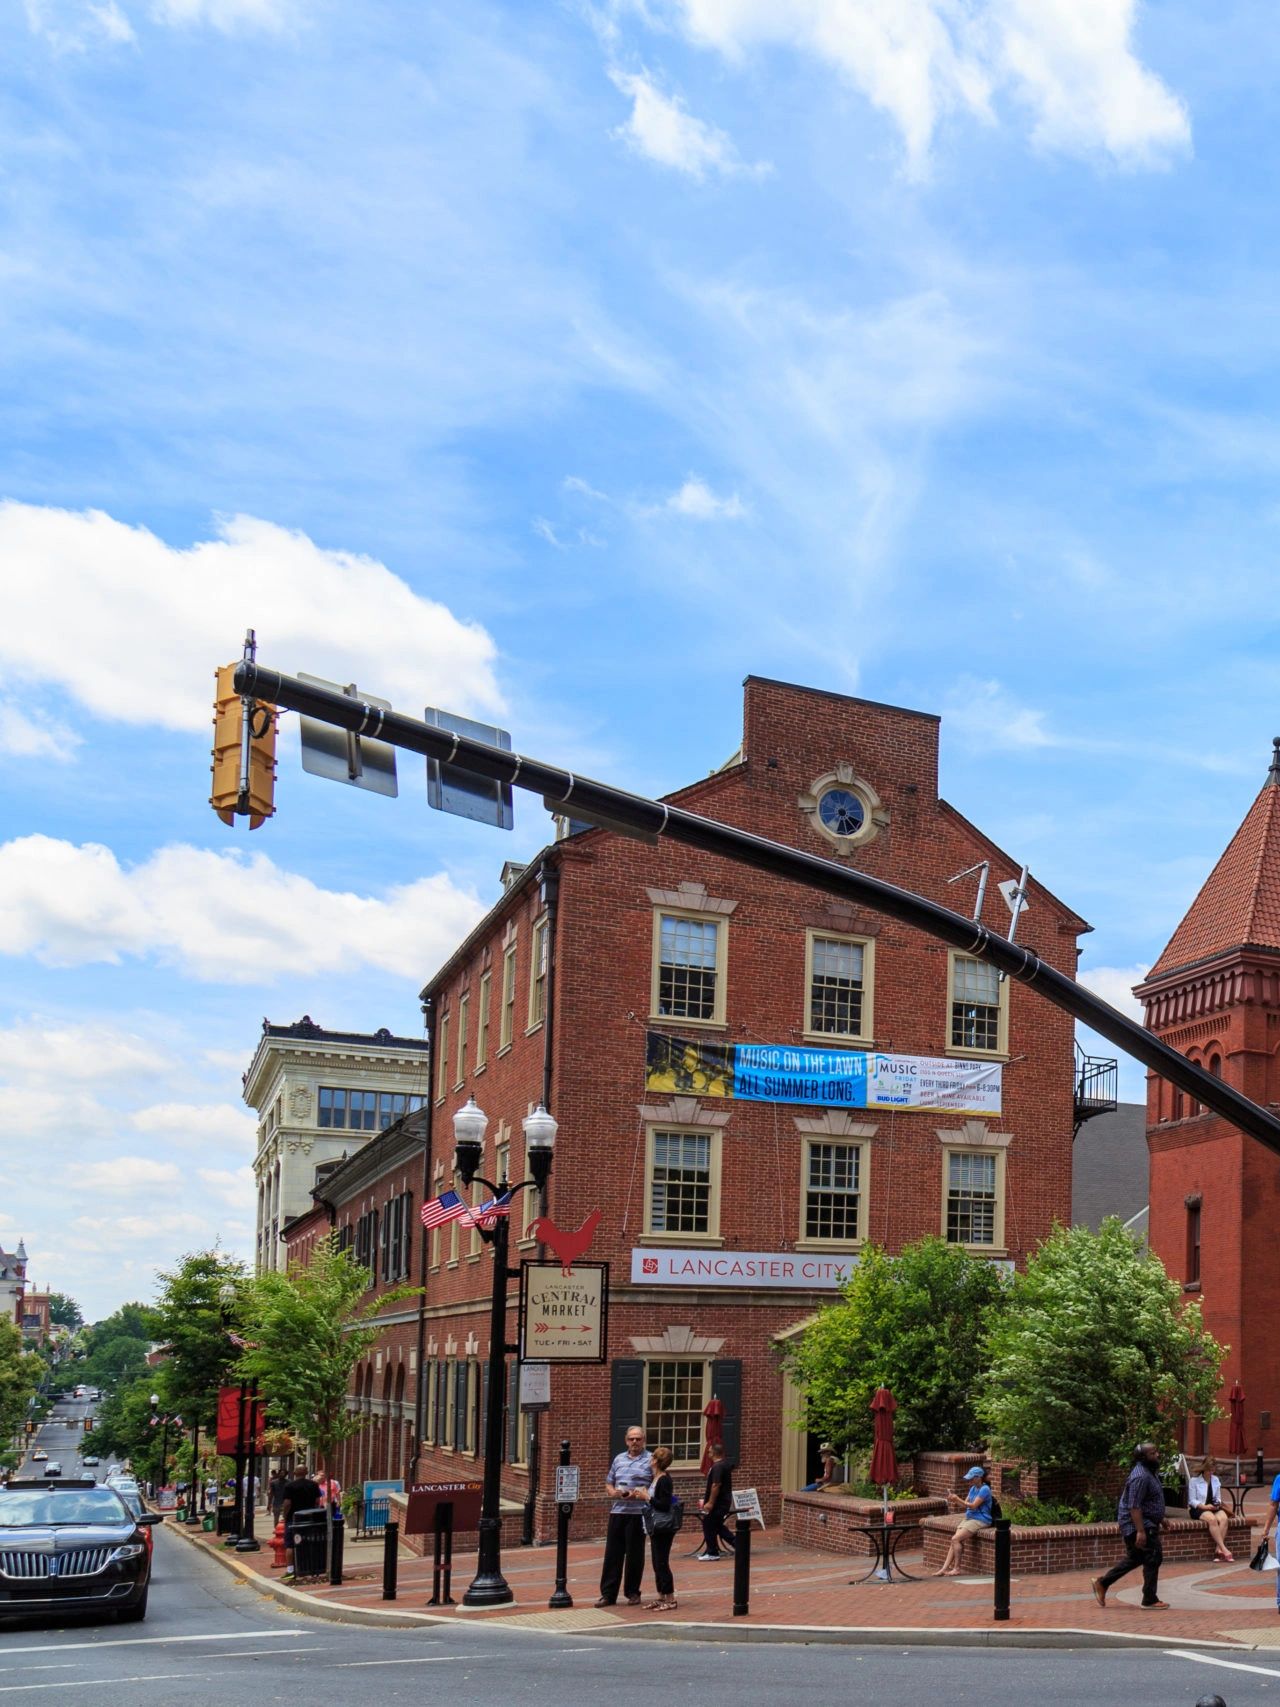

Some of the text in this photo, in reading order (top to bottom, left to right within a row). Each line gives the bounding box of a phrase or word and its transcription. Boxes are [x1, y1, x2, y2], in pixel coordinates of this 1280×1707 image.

[740, 1047, 866, 1076] MUSIC ON THE LAWN.
[880, 1063, 917, 1075] MUSIC
[894, 1075, 917, 1083] FRIDAY
[920, 1079, 934, 1087] EVERY
[740, 1074, 856, 1102] ALL SUMMER LONG.
[670, 1259, 846, 1278] LANCASTER CITY
[531, 1291, 598, 1307] CENTRAL
[542, 1304, 586, 1316] MARKET
[412, 1482, 481, 1492] LANCASTER City
